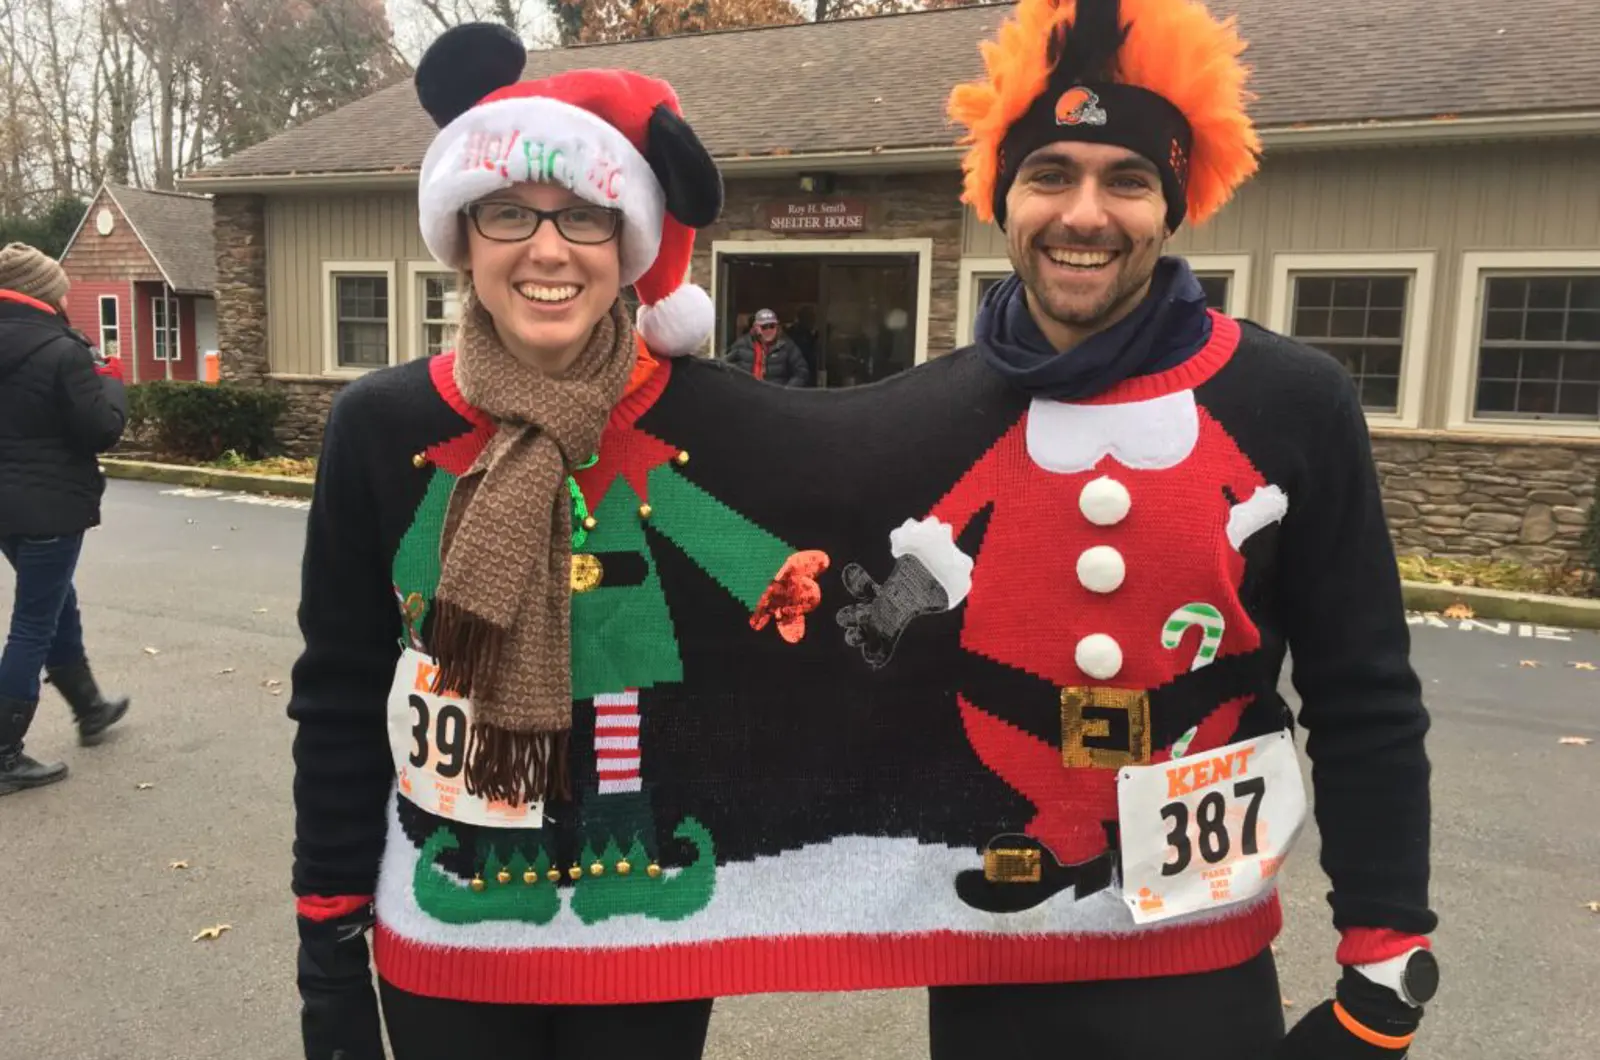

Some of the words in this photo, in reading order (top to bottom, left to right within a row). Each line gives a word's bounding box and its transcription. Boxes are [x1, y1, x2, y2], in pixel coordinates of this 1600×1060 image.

[770, 217, 820, 229] SHELTER
[824, 216, 863, 228] HOUSE
[788, 204, 805, 216] Roy
[821, 202, 846, 213] Smith
[1405, 610, 1572, 641] ANE
[408, 694, 467, 778] 39
[1166, 745, 1256, 798] KENT
[1160, 776, 1266, 877] 387
[1201, 866, 1233, 880] PARKS
